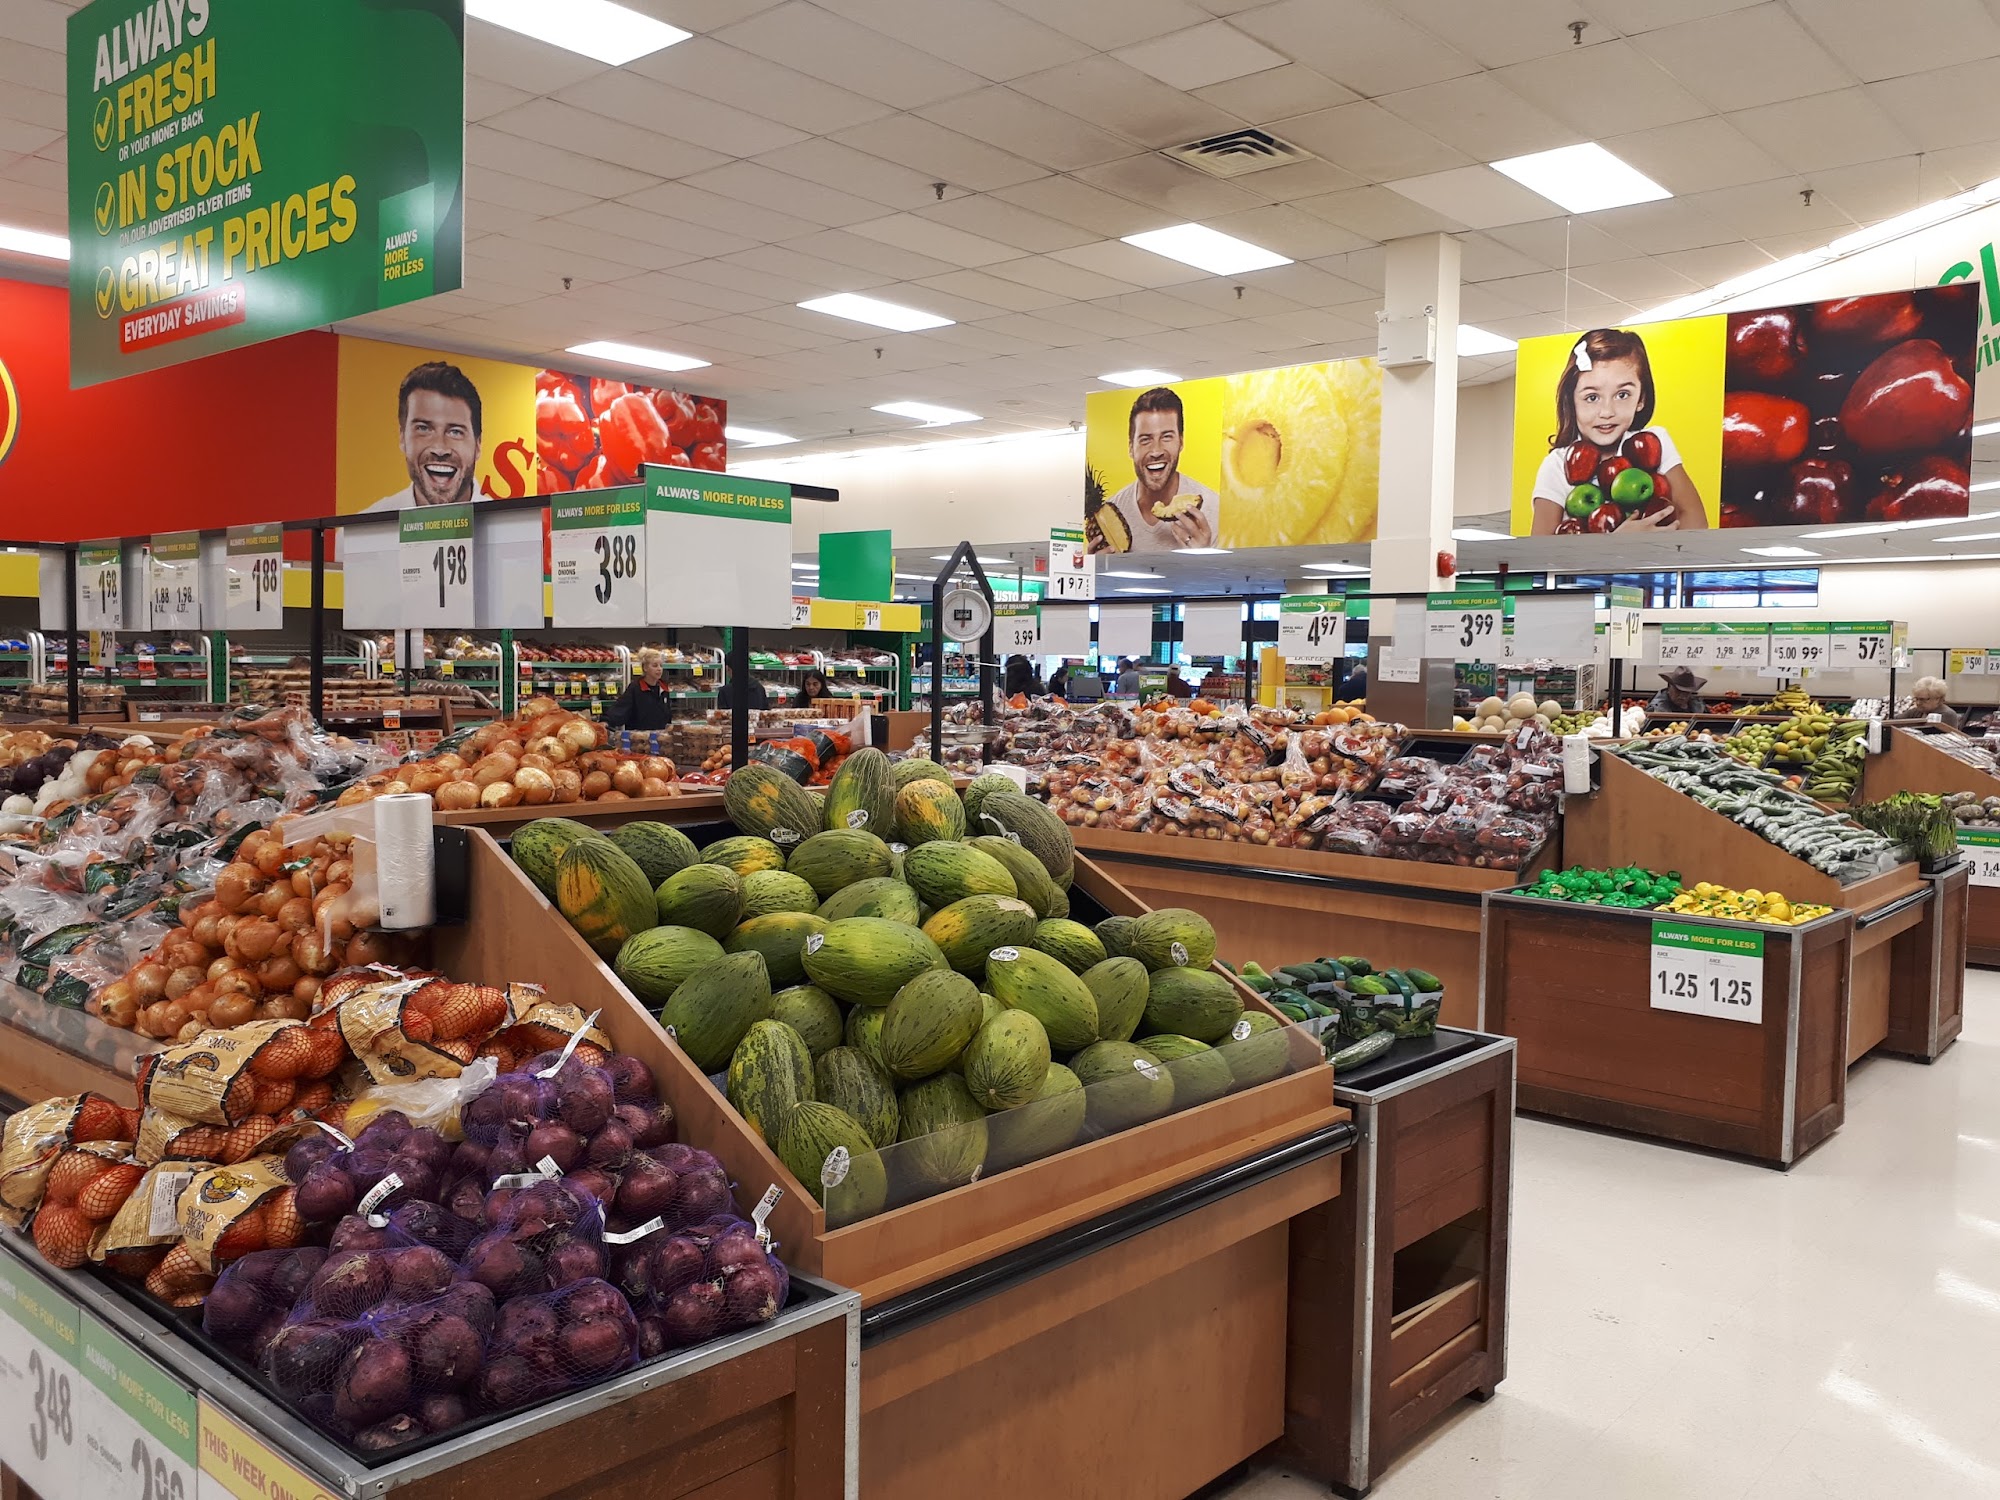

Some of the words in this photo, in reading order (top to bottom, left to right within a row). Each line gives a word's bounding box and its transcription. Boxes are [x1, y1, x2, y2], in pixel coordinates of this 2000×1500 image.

[94, 0, 209, 93] ALWAYS
[117, 37, 216, 143] FRESH
[119, 146, 129, 162] OR
[130, 139, 150, 157] YOUR
[151, 120, 180, 148] MONEY
[181, 108, 204, 133] BACK
[118, 164, 147, 229] IN
[156, 111, 262, 212] STOCK
[130, 227, 147, 244] OUR
[148, 205, 195, 237] ADVERTISED
[197, 194, 223, 219] FLYER
[224, 182, 252, 207] ITEMS
[118, 226, 214, 312] GREAT
[223, 174, 358, 280] PRICES
[385, 229, 418, 251] ALWAYS
[384, 246, 409, 266] MORE
[384, 265, 401, 281] FOR
[402, 257, 424, 276] LESS
[124, 307, 181, 344] EVERYDAY
[184, 291, 238, 325] SAVINGS
[557, 507, 583, 519] ALWAYS
[584, 505, 605, 516] MORE
[607, 504, 621, 514] FOR
[622, 502, 641, 512] LESS
[656, 486, 700, 500] ALWAYS
[703, 491, 735, 504] MORE
[737, 495, 757, 506] FOR
[760, 497, 785, 509] LESS
[403, 522, 424, 532] ALWAYS
[425, 520, 441, 529] MORE
[441, 519, 453, 528] FOR
[454, 518, 469, 527] LESS
[259, 536, 267, 544] FOR
[1014, 630, 1034, 646] 3.99
[1662, 646, 1678, 654] 2.47
[1687, 646, 1703, 654] 2.47
[1716, 646, 1733, 654] 1.98
[1742, 646, 1759, 654] 1.98
[1658, 931, 1689, 941] ALWAYS
[1691, 935, 1715, 944] MORE
[1717, 939, 1733, 947] FOR
[1735, 941, 1756, 949] LESS
[1657, 970, 1698, 999] 1.25
[1709, 977, 1753, 1007] 1.25
[39, 1308, 55, 1331] FOR
[55, 1321, 75, 1345] LESS
[86, 1344, 117, 1381] ALWAYS
[118, 1370, 145, 1403] MORE
[145, 1391, 165, 1419] FOR
[166, 1406, 190, 1440] LESS
[203, 1426, 229, 1464] THIS
[231, 1448, 267, 1495] WEEK
